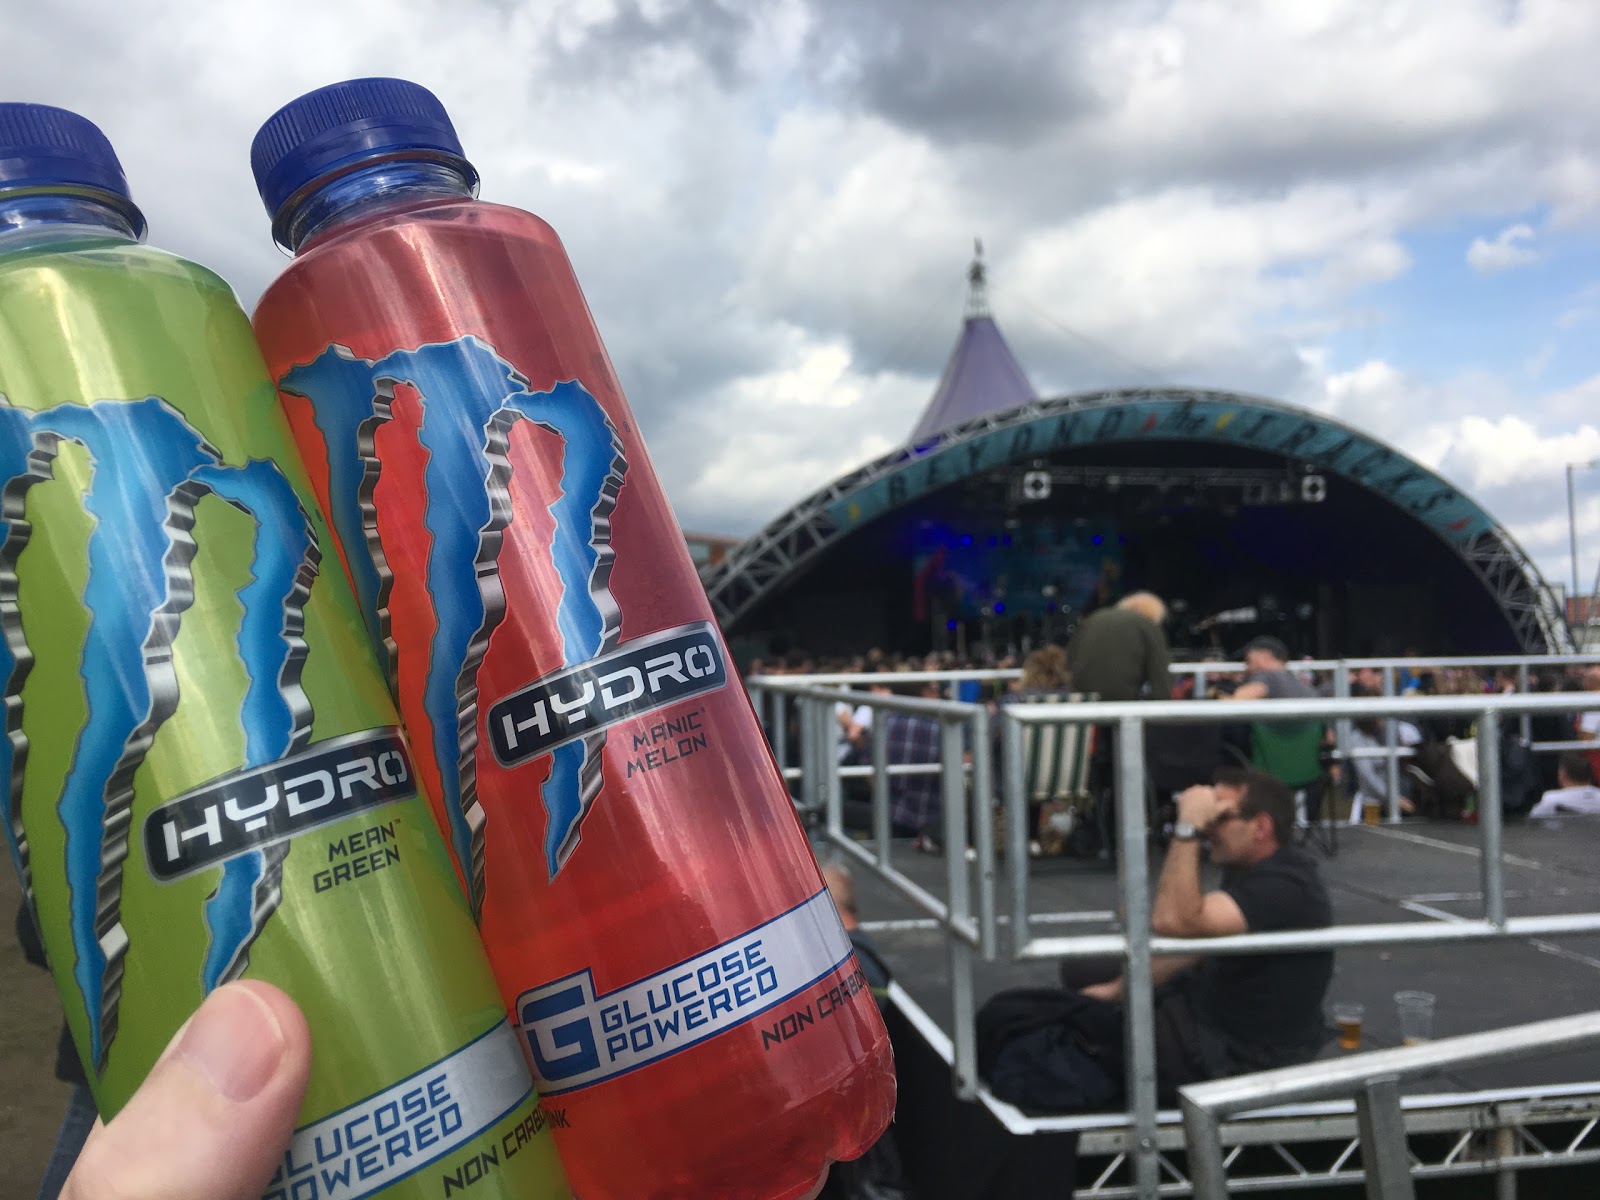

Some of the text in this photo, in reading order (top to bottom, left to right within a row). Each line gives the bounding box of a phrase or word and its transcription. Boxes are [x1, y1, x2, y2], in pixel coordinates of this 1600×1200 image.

[502, 644, 716, 750] HYDRO
[627, 732, 708, 779] MELON
[633, 710, 703, 751] MANIC
[162, 750, 408, 862] HYDRO
[328, 821, 396, 863] MEAN
[313, 844, 401, 894] GREEN
[600, 940, 767, 1034] GLUCOSE
[607, 966, 778, 1062] POWERED
[761, 1008, 813, 1051] NON
[442, 1145, 500, 1198] NON
